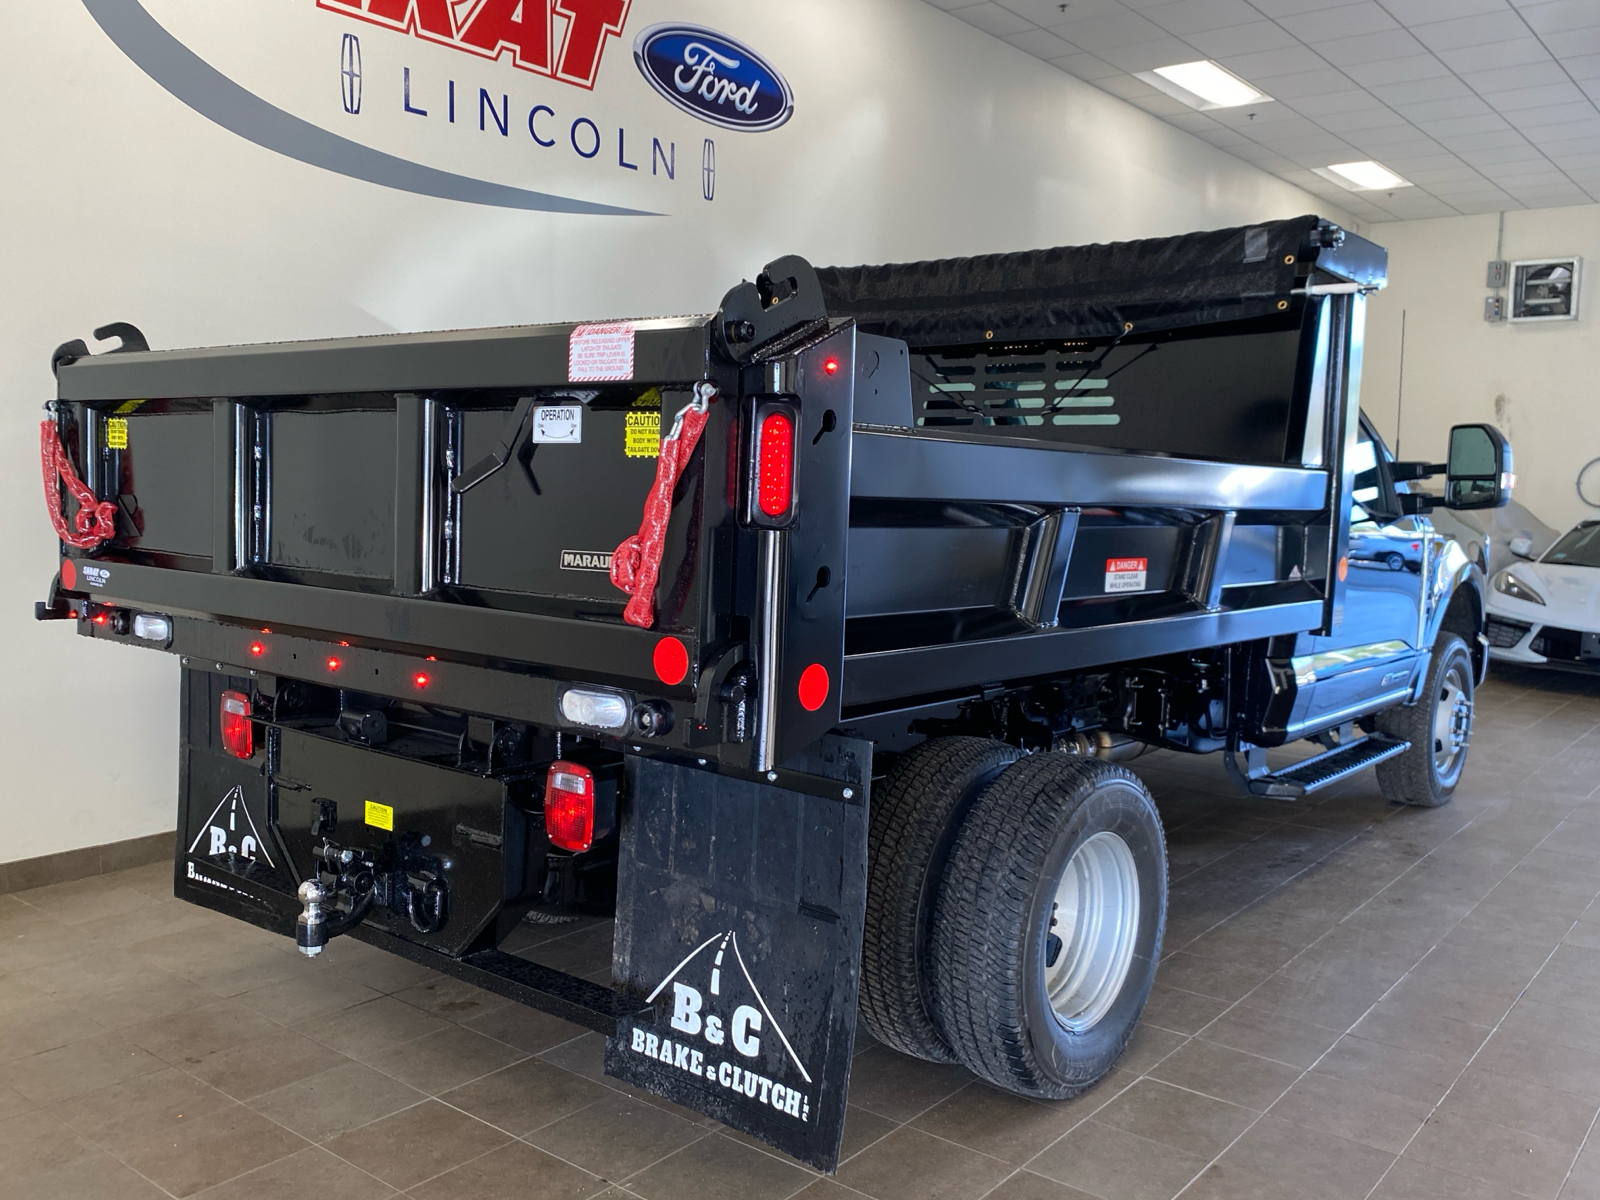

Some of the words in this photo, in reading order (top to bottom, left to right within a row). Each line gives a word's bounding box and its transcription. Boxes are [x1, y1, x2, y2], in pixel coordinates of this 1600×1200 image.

[674, 42, 760, 115] Ford
[404, 66, 675, 180] LINCOLN
[541, 409, 575, 421] OPERATION
[627, 415, 660, 426] CAUTIO
[563, 553, 613, 568] MARAU
[1116, 560, 1138, 570] DANGER
[631, 1027, 704, 1077] BRAKE
[706, 1064, 717, 1081] &
[719, 1061, 802, 1119] CLUTCH
